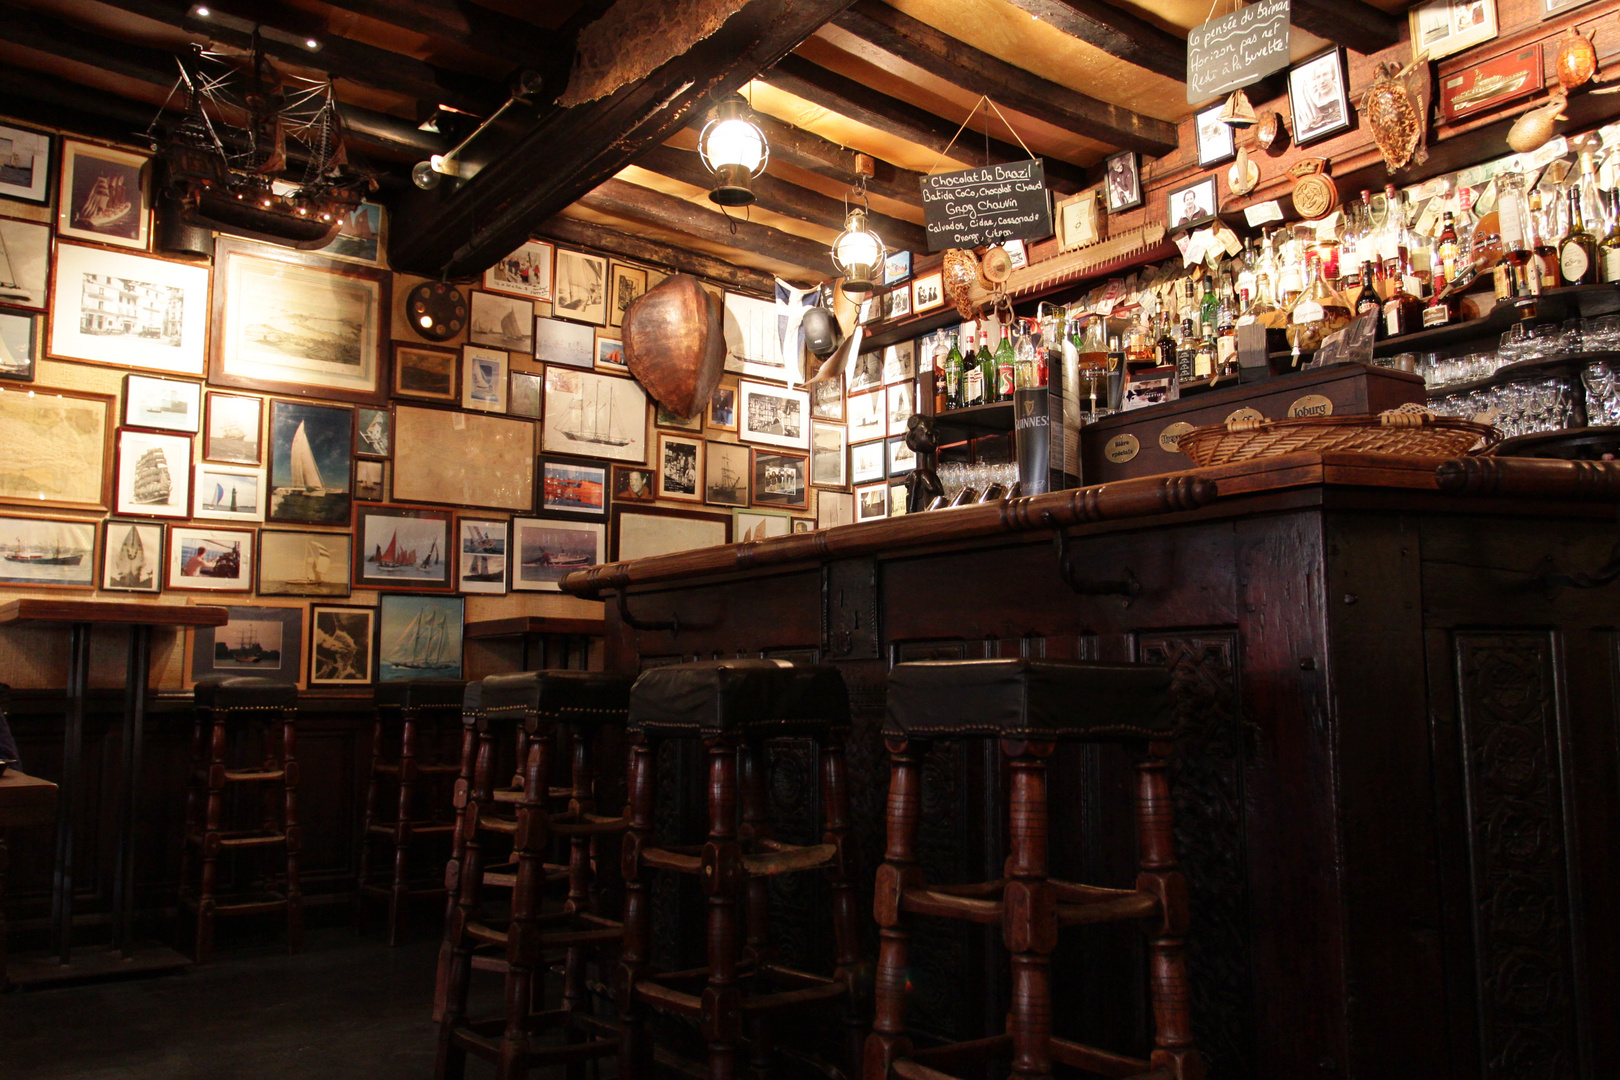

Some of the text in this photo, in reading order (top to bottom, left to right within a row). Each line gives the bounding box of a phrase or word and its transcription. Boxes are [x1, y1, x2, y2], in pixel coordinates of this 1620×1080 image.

[1204, 16, 1237, 48] pensée
[1240, 10, 1254, 25] du
[1190, 43, 1236, 72] Horizon
[1240, 34, 1258, 55] pas
[1232, 55, 1242, 71] la
[923, 188, 955, 202] Batida
[979, 183, 1012, 197] Chocolat
